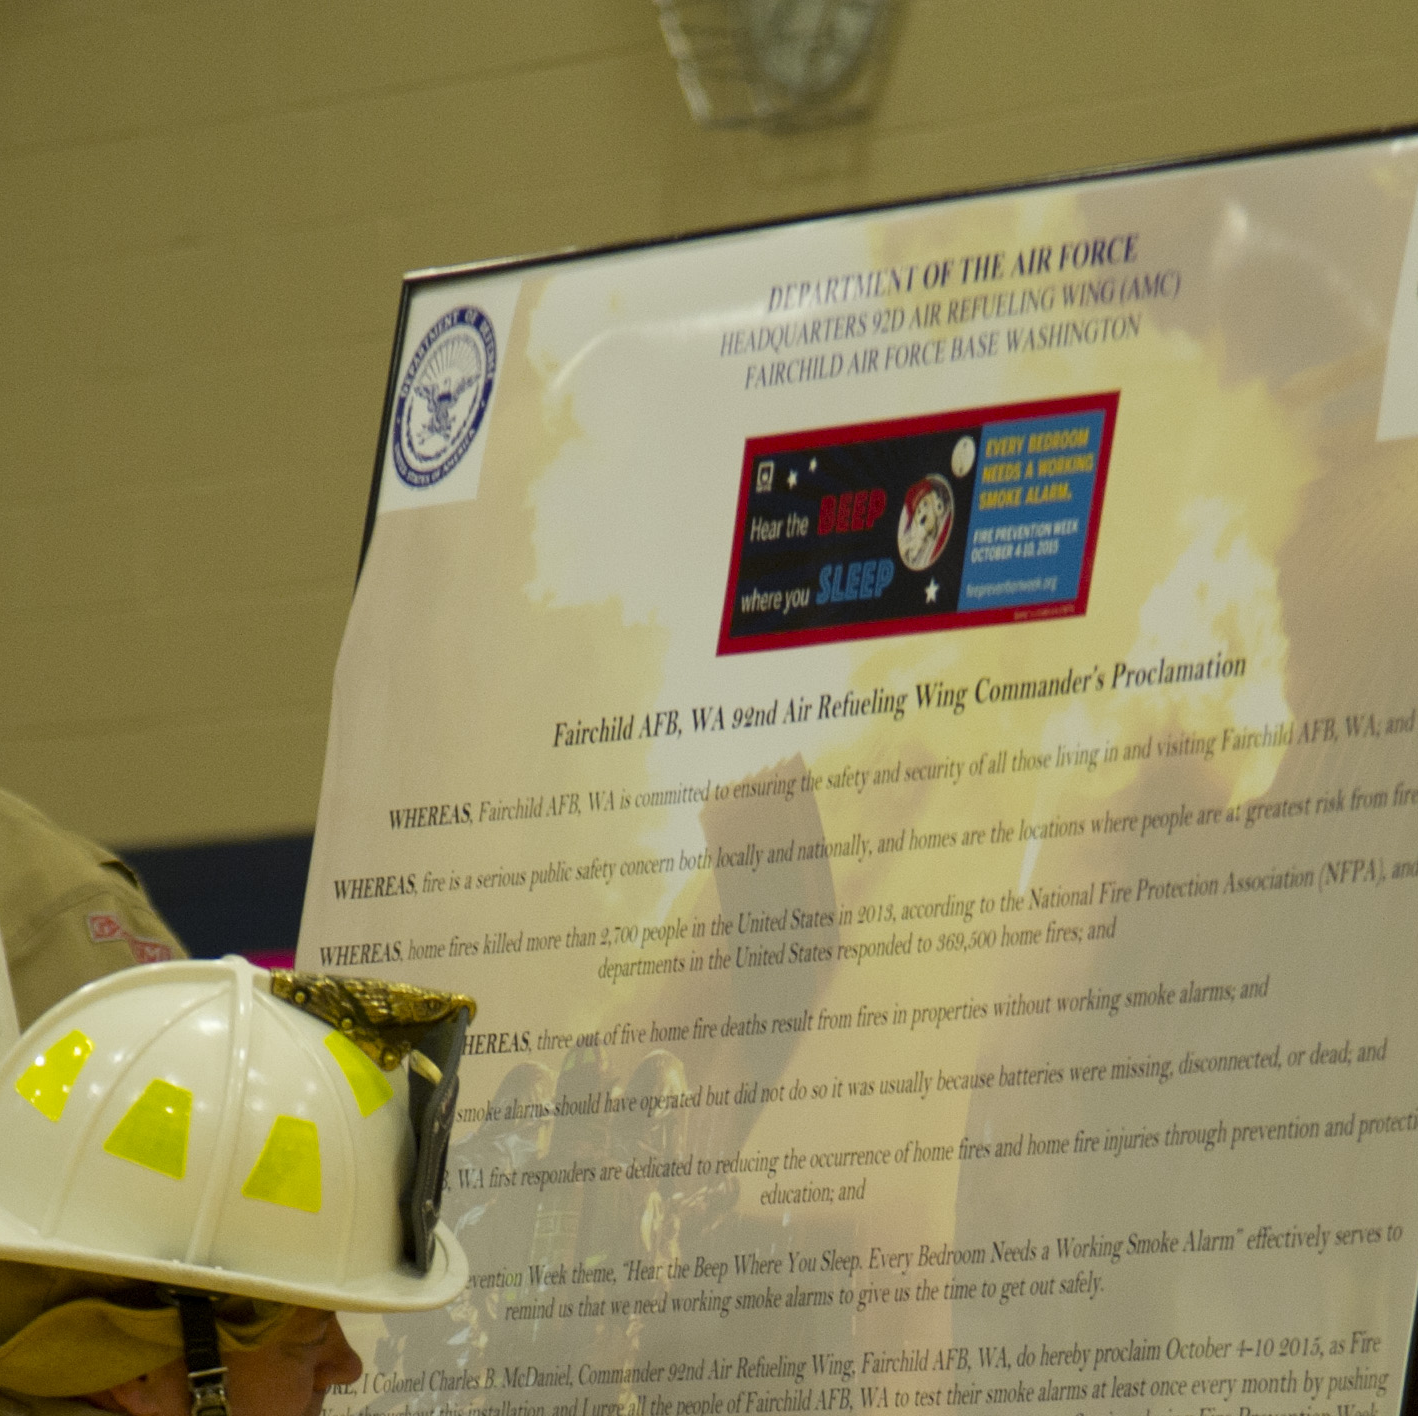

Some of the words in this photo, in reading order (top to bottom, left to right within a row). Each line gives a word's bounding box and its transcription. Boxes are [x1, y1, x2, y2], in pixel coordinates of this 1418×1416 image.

[767, 265, 915, 312] DEPARTMENT
[921, 259, 954, 289] OF
[960, 252, 1005, 285] THE
[1010, 245, 1052, 277] AIR
[1058, 233, 1138, 271] FORCE
[720, 313, 867, 355] HEADQUARTERS
[871, 306, 905, 334] 92D
[908, 302, 941, 329] AIR
[947, 285, 1055, 323] REFUELING
[1062, 278, 1115, 307] WING
[1119, 270, 1181, 302] (AMC)
[744, 352, 844, 389] FAIRCHILD
[846, 348, 879, 375] AIR
[884, 339, 943, 370] FORCE
[950, 331, 996, 361] BASE
[1006, 314, 1140, 351] WASHINGTON
[982, 462, 1022, 484] NEEDS
[1025, 461, 1034, 479] A
[1038, 453, 1094, 477] WORKING
[986, 436, 1025, 458] EVERY
[1028, 428, 1090, 453] BEDROOM
[750, 513, 783, 543] Hear
[786, 511, 810, 539] the
[817, 488, 887, 537] BEEP
[979, 487, 1023, 511] SMOKE
[1025, 482, 1072, 505] ALARM.
[970, 544, 1013, 564] OCTOBER
[973, 528, 994, 544] FIRE
[994, 521, 1052, 542] PREVENTION
[1053, 519, 1079, 536] WEEK
[741, 589, 782, 614] where
[783, 590, 810, 616] you
[815, 558, 895, 606] SLEEP
[552, 713, 635, 748] Fairchild
[637, 708, 682, 739] AFB,
[690, 704, 725, 732] WA
[730, 698, 779, 729] 92nd
[781, 695, 813, 724] Air
[817, 687, 908, 721] Refueling
[915, 680, 968, 715] Wing
[973, 664, 1105, 704] Commander's
[1110, 651, 1246, 689] Proclamation
[388, 801, 473, 829] WHEREAS,
[478, 795, 543, 822] Fairchild
[545, 792, 581, 817] AFB,
[587, 789, 615, 811] WA
[619, 794, 631, 810] is
[634, 779, 711, 808] committed
[714, 783, 730, 801] to
[732, 773, 796, 801] ensuring
[799, 769, 823, 793] the
[826, 764, 870, 794] safety
[872, 760, 901, 785] and
[903, 760, 964, 785] security
[968, 751, 988, 776] of
[986, 750, 1007, 775] all
[1011, 748, 1052, 772] those
[1055, 744, 1100, 772] living
[1103, 746, 1119, 763] in
[1122, 735, 1153, 760] and
[1156, 736, 1217, 760] visiting
[1220, 722, 1293, 751] Fairchild
[1296, 716, 1338, 744] AFB,
[1345, 713, 1380, 738] WA;
[1385, 707, 1416, 734] and
[319, 942, 403, 967] WHEREAS,
[407, 938, 445, 960] home
[448, 934, 479, 957] fires
[482, 930, 523, 955] killed
[525, 934, 562, 952] more
[564, 925, 596, 948] than
[599, 924, 639, 947] 2,700
[640, 916, 688, 949] people
[691, 916, 706, 938] in
[709, 913, 734, 936] the
[737, 908, 788, 934] United
[789, 907, 834, 930] States
[838, 903, 853, 926] in
[856, 902, 896, 924] 2013,
[900, 894, 975, 923] according
[979, 896, 995, 914] to
[999, 888, 1024, 912] the
[1028, 882, 1095, 910] National
[1098, 880, 1132, 904] Fire
[1135, 874, 1218, 901] Protection
[1223, 870, 1314, 894] Association
[1318, 858, 1386, 892] (NFPA),
[333, 873, 417, 900] WHEREAS,
[597, 956, 685, 984] departments
[688, 949, 704, 972] in
[707, 947, 731, 970] the
[735, 942, 786, 968] United
[787, 941, 832, 963] States
[836, 931, 913, 965] responded
[916, 935, 933, 954] to
[935, 930, 997, 952] 369,500
[1000, 923, 1042, 947] home
[1044, 919, 1083, 943] fires;
[1086, 914, 1117, 940] and
[759, 1181, 834, 1205] education;
[837, 1176, 867, 1201] and
[504, 1296, 555, 1320] remind
[557, 1303, 574, 1318] us
[577, 1294, 606, 1317] that
[610, 1299, 630, 1315] we
[633, 1291, 668, 1314] need
[671, 1289, 732, 1318] working
[734, 1285, 782, 1309] smoke
[784, 1284, 833, 1308] alarms
[838, 1287, 854, 1305] to
[856, 1281, 890, 1312] give
[893, 1287, 910, 1303] us
[914, 1277, 939, 1301] the
[942, 1276, 977, 1300] time
[980, 1280, 997, 1298] to
[998, 1278, 1026, 1305] get
[1028, 1276, 1056, 1296] out
[1058, 1269, 1103, 1300] safely.
[1015, 1343, 1036, 1367] do
[1039, 1341, 1091, 1372] hereby
[1092, 1338, 1161, 1371] proclaim
[1164, 1335, 1232, 1360] October
[1278, 1335, 1323, 1358] 2015,
[1328, 1338, 1345, 1355] as
[1349, 1329, 1381, 1354] Fire
